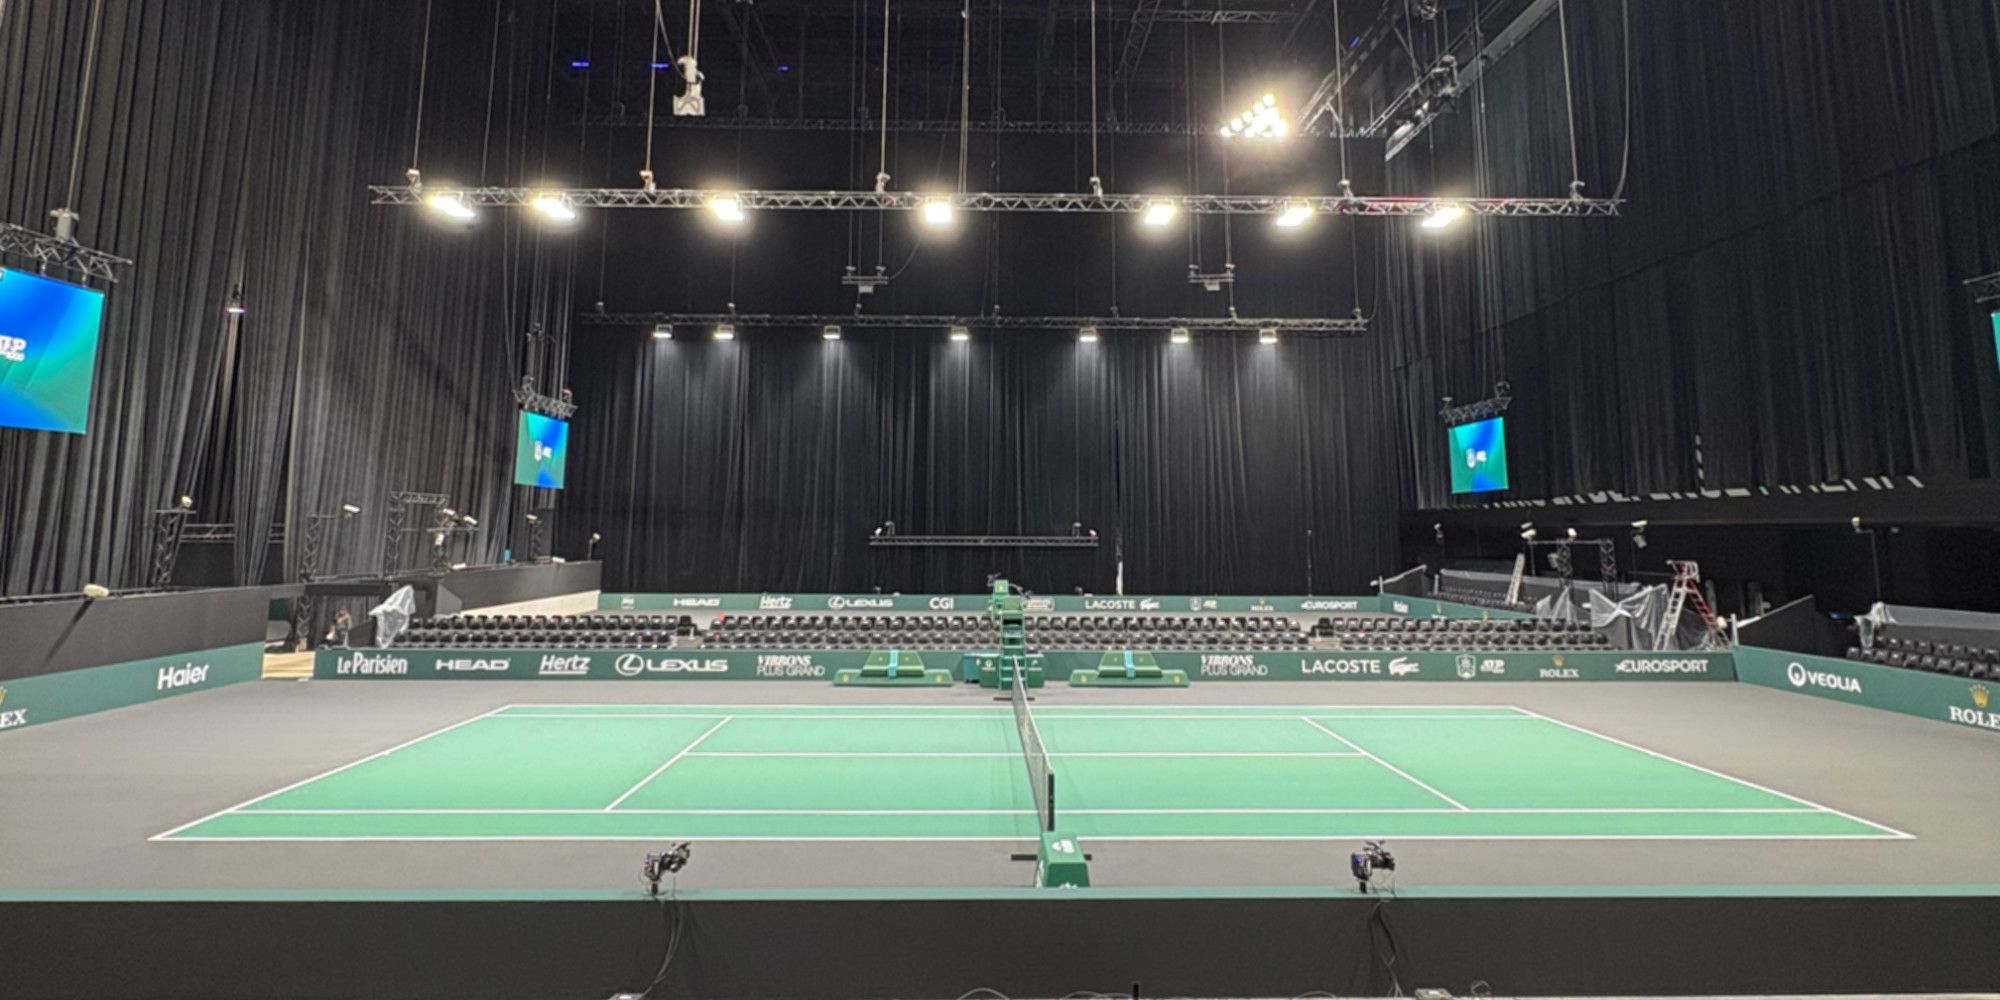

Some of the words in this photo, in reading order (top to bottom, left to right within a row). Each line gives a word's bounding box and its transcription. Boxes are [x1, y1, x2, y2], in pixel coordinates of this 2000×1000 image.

[760, 594, 792, 608] Hertz
[846, 599, 894, 608] LEXUS
[929, 597, 954, 610] CGI
[1085, 600, 1136, 610] LACOSTE
[435, 658, 510, 671] HEAD
[540, 655, 591, 672] Hertz
[647, 659, 729, 672] LEXUS
[1301, 659, 1381, 674] LACOSTE
[1621, 659, 1709, 673] EUROSPORT
[157, 663, 210, 690] Haier
[756, 665, 784, 676] PLUS
[786, 665, 826, 676] GRAND
[1200, 665, 1228, 676] PLUS
[1229, 665, 1269, 676] GRAND
[1539, 668, 1580, 679] ROLEX
[1807, 671, 1862, 693] VEOLIA
